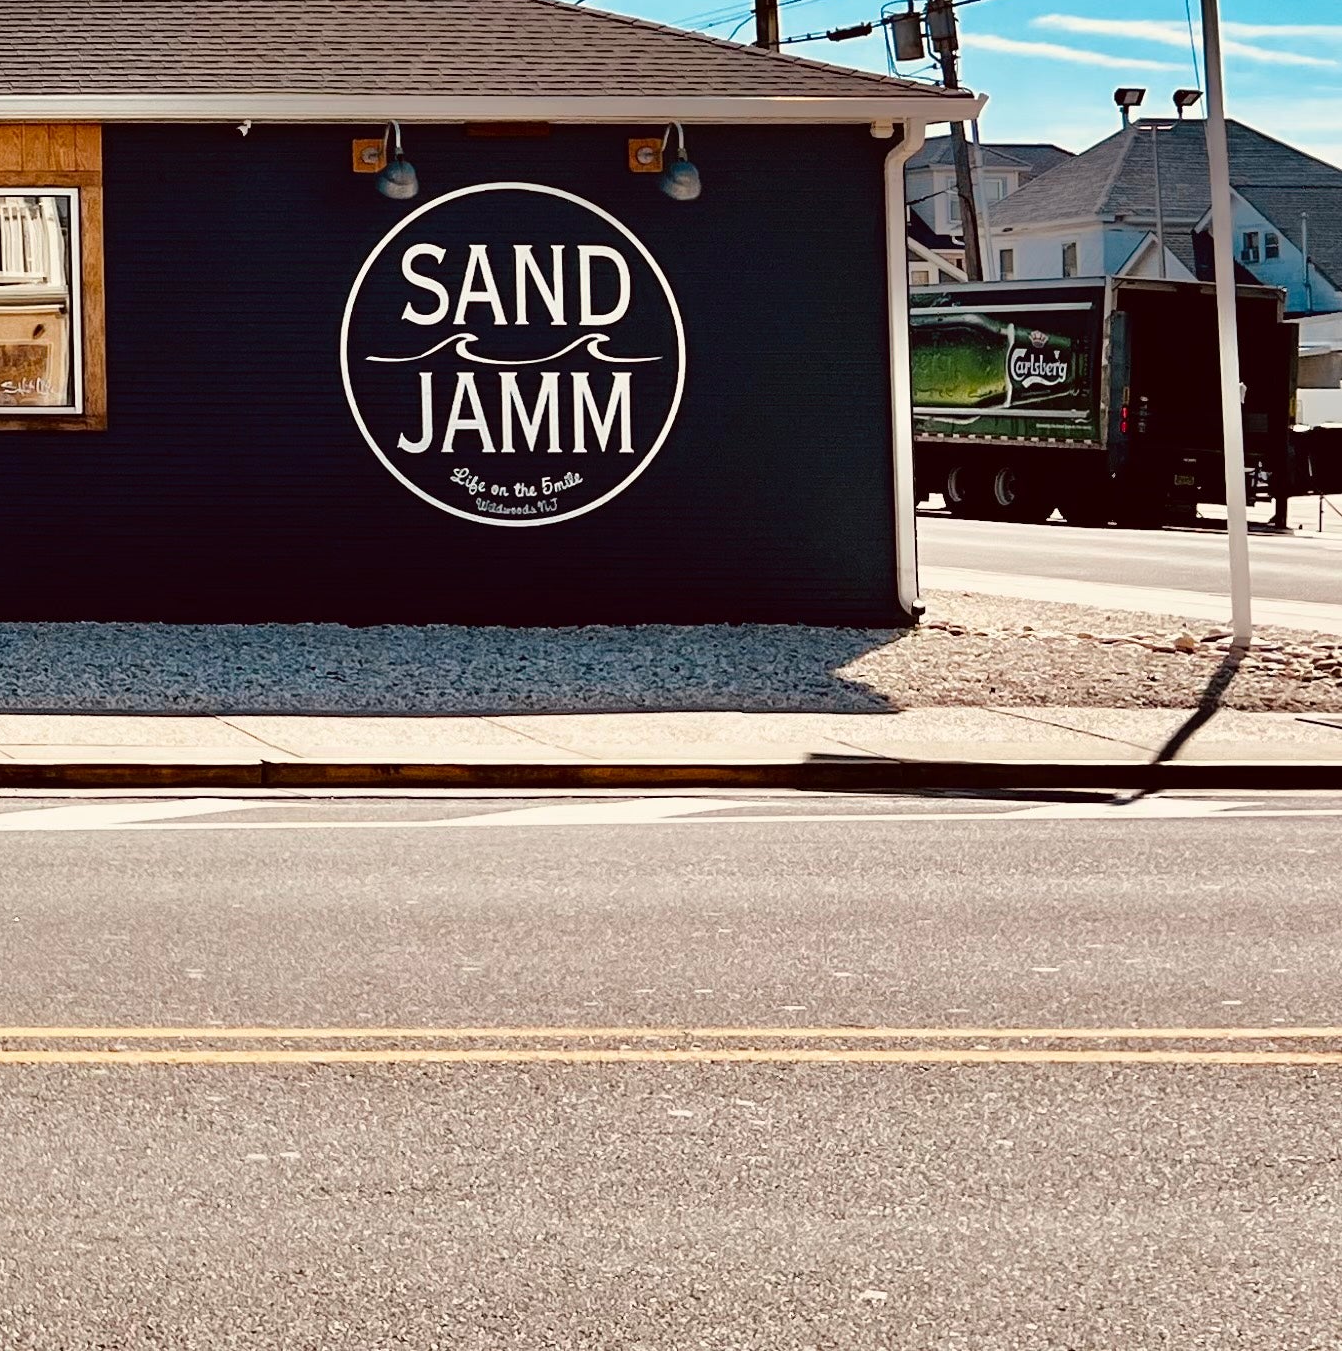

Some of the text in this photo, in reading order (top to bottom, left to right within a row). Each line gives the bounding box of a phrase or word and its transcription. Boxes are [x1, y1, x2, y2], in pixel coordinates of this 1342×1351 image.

[401, 243, 631, 326] SAND
[1010, 348, 1068, 388] Carlsberg
[397, 371, 634, 454] JAMM
[450, 467, 486, 496] Life
[490, 484, 509, 497] on
[513, 482, 538, 498] the
[538, 498, 558, 513] NJ
